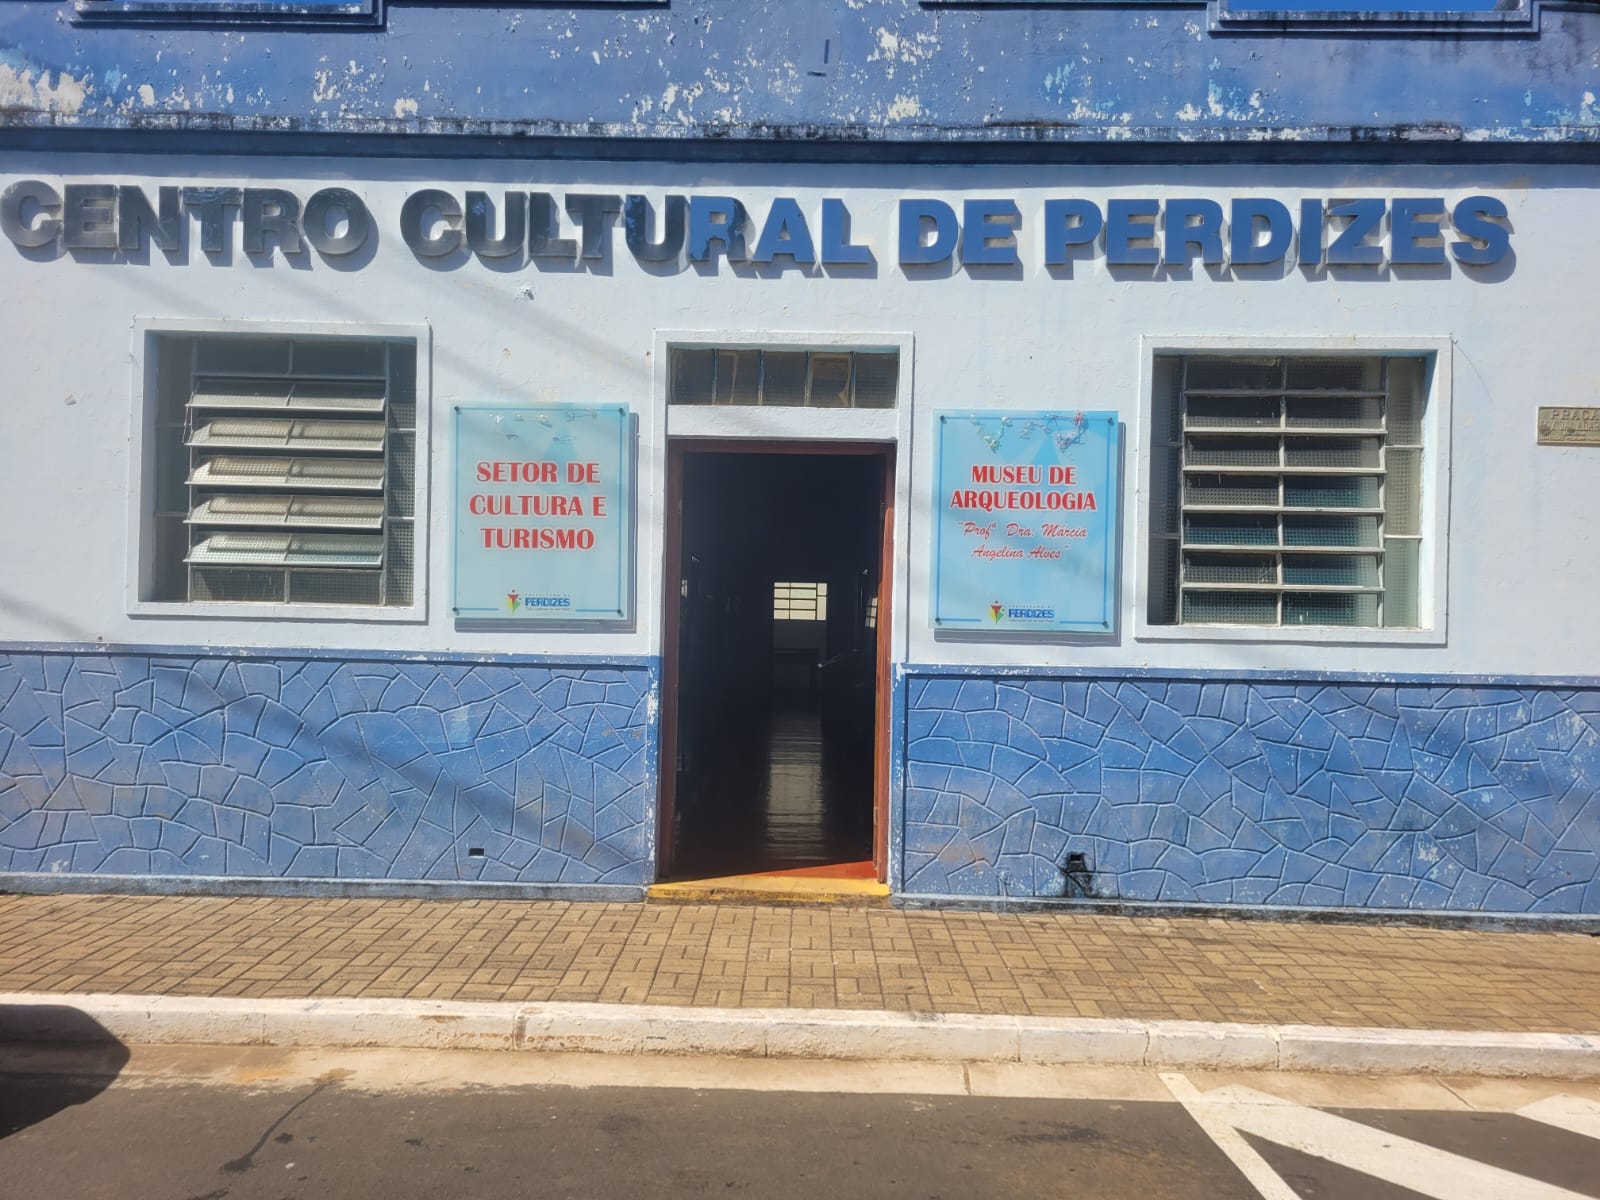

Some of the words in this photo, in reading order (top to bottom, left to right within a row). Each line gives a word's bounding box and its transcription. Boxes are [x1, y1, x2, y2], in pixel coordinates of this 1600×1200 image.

[1, 179, 371, 257] CENTRO
[400, 187, 873, 266] CULTURAL
[899, 197, 1020, 268] DE
[1044, 195, 1512, 270] PERDIZES
[476, 461, 558, 483] SETOR
[567, 462, 601, 483] DE
[971, 465, 1042, 484] MUSEU
[1049, 466, 1077, 485] DE
[469, 495, 584, 516] CULTURA
[592, 496, 607, 517] E
[950, 490, 1097, 512] ARQUEOLOGIA
[480, 528, 595, 550] TURISMO
[1006, 522, 1034, 538] Dra.
[1041, 524, 1088, 538] Márcia
[970, 544, 1025, 561] Angelina
[525, 597, 571, 607] PERDIZES
[1008, 608, 1056, 619] PERDIZES
